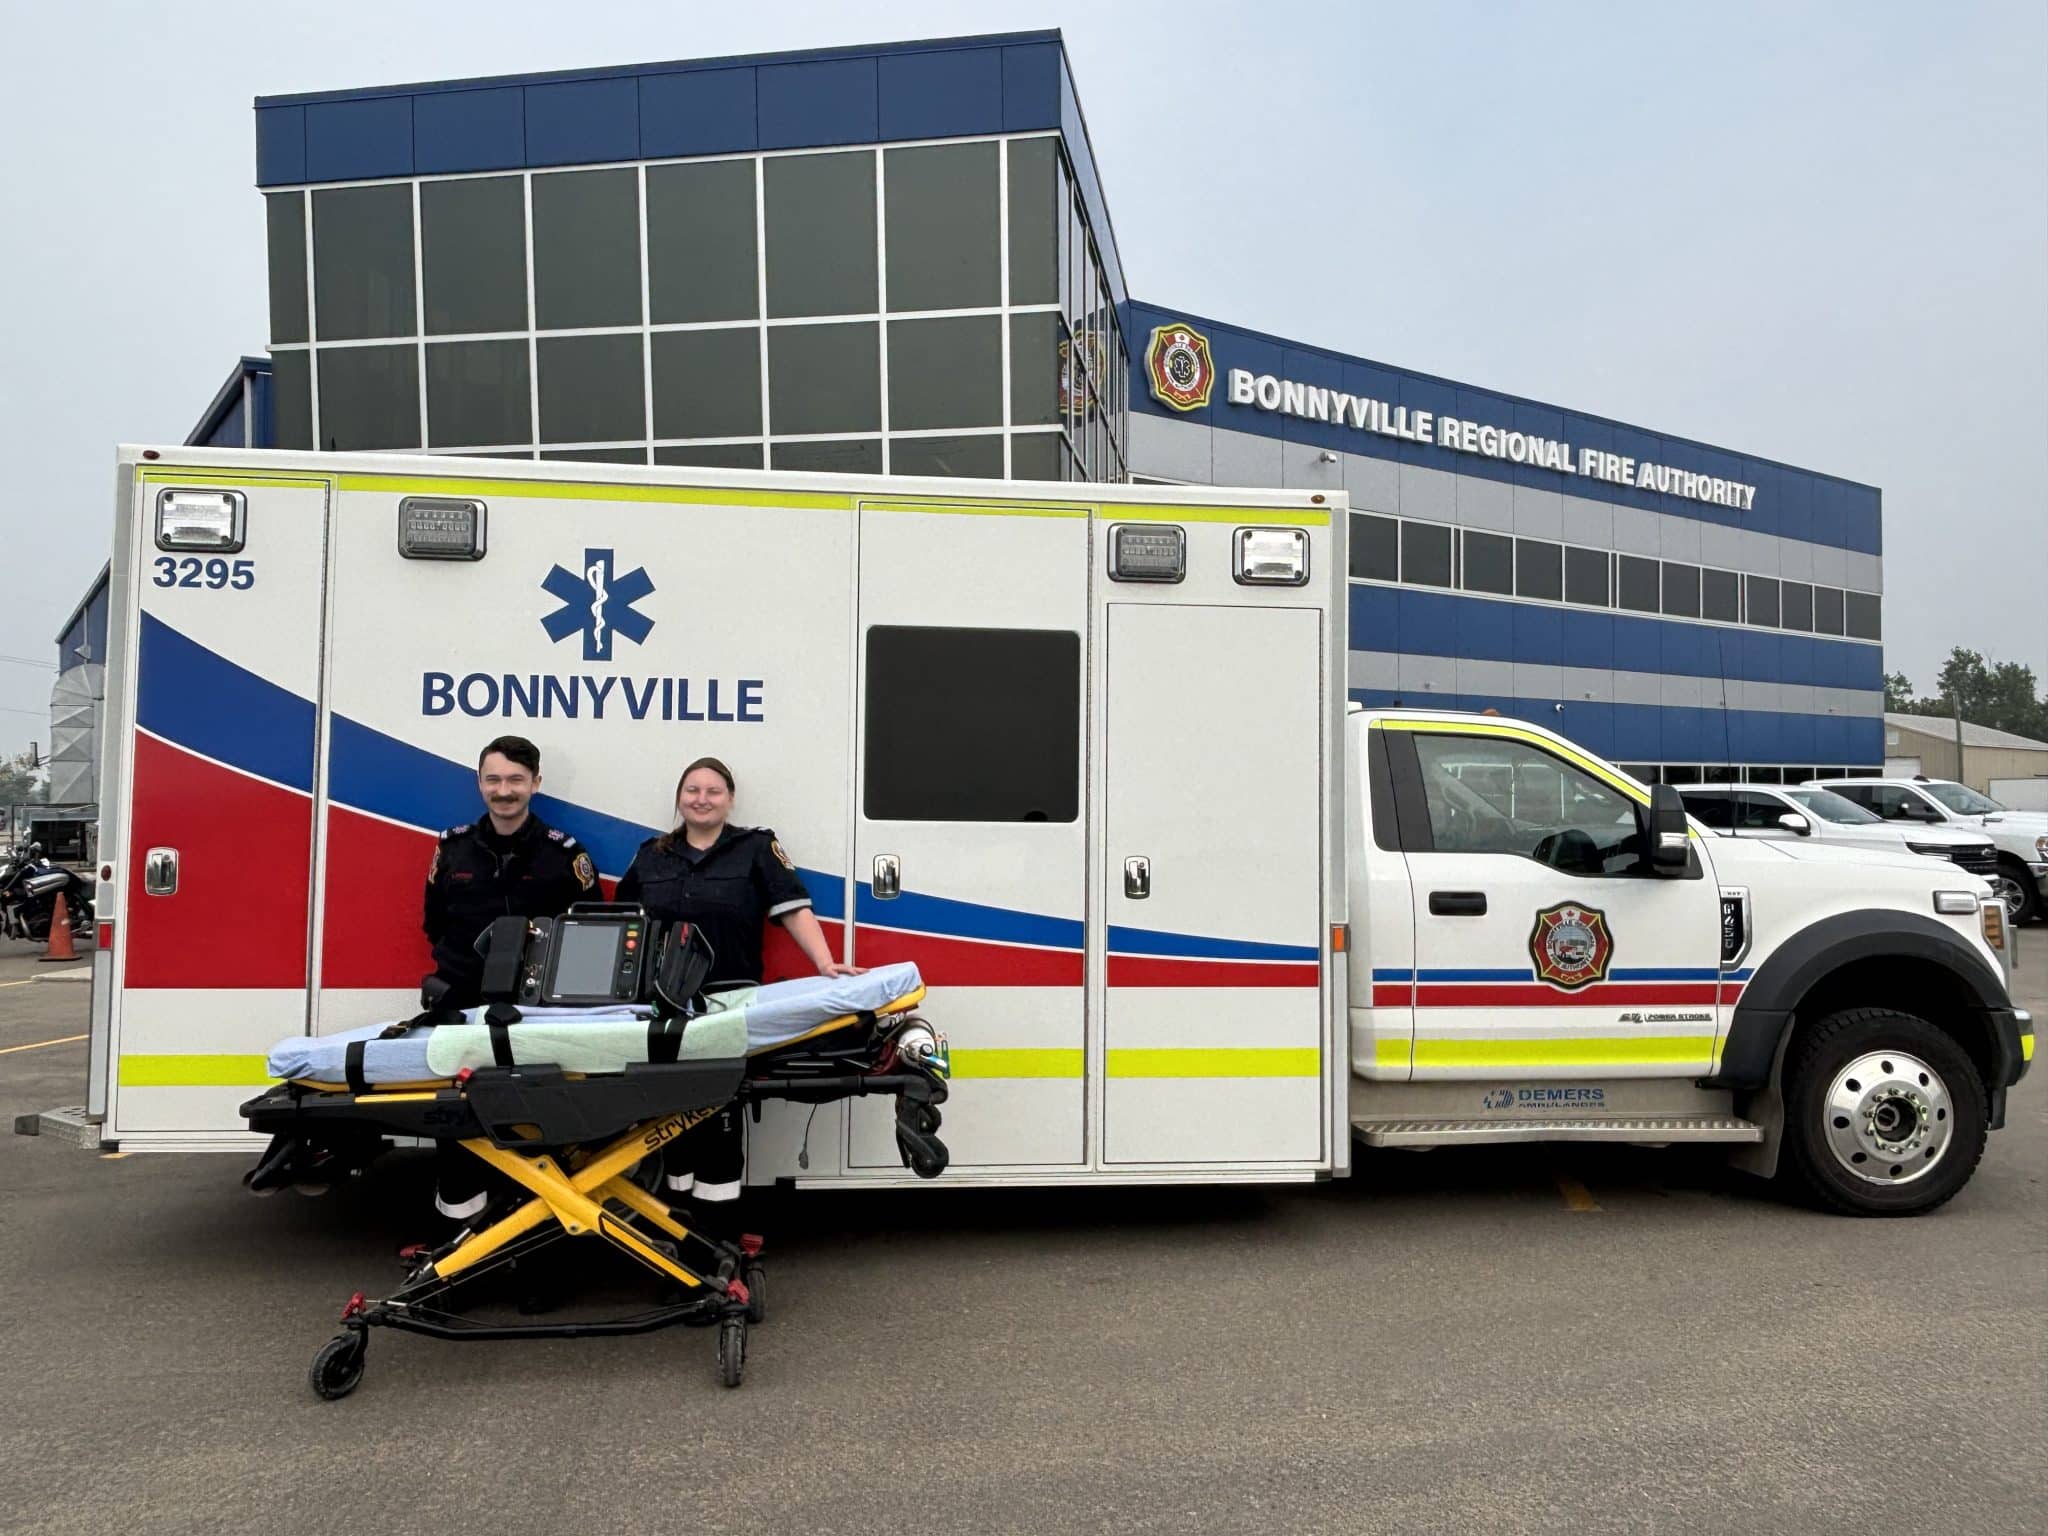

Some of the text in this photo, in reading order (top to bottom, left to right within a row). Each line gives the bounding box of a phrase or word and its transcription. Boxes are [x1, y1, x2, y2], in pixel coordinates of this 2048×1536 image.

[1230, 368, 1756, 510] BONNYVILLE REGIONAL FIRE AUTHORITY
[152, 556, 255, 591] 3295
[422, 671, 764, 723] BONNYVILLE
[1518, 1088, 1604, 1101] DEMERS
